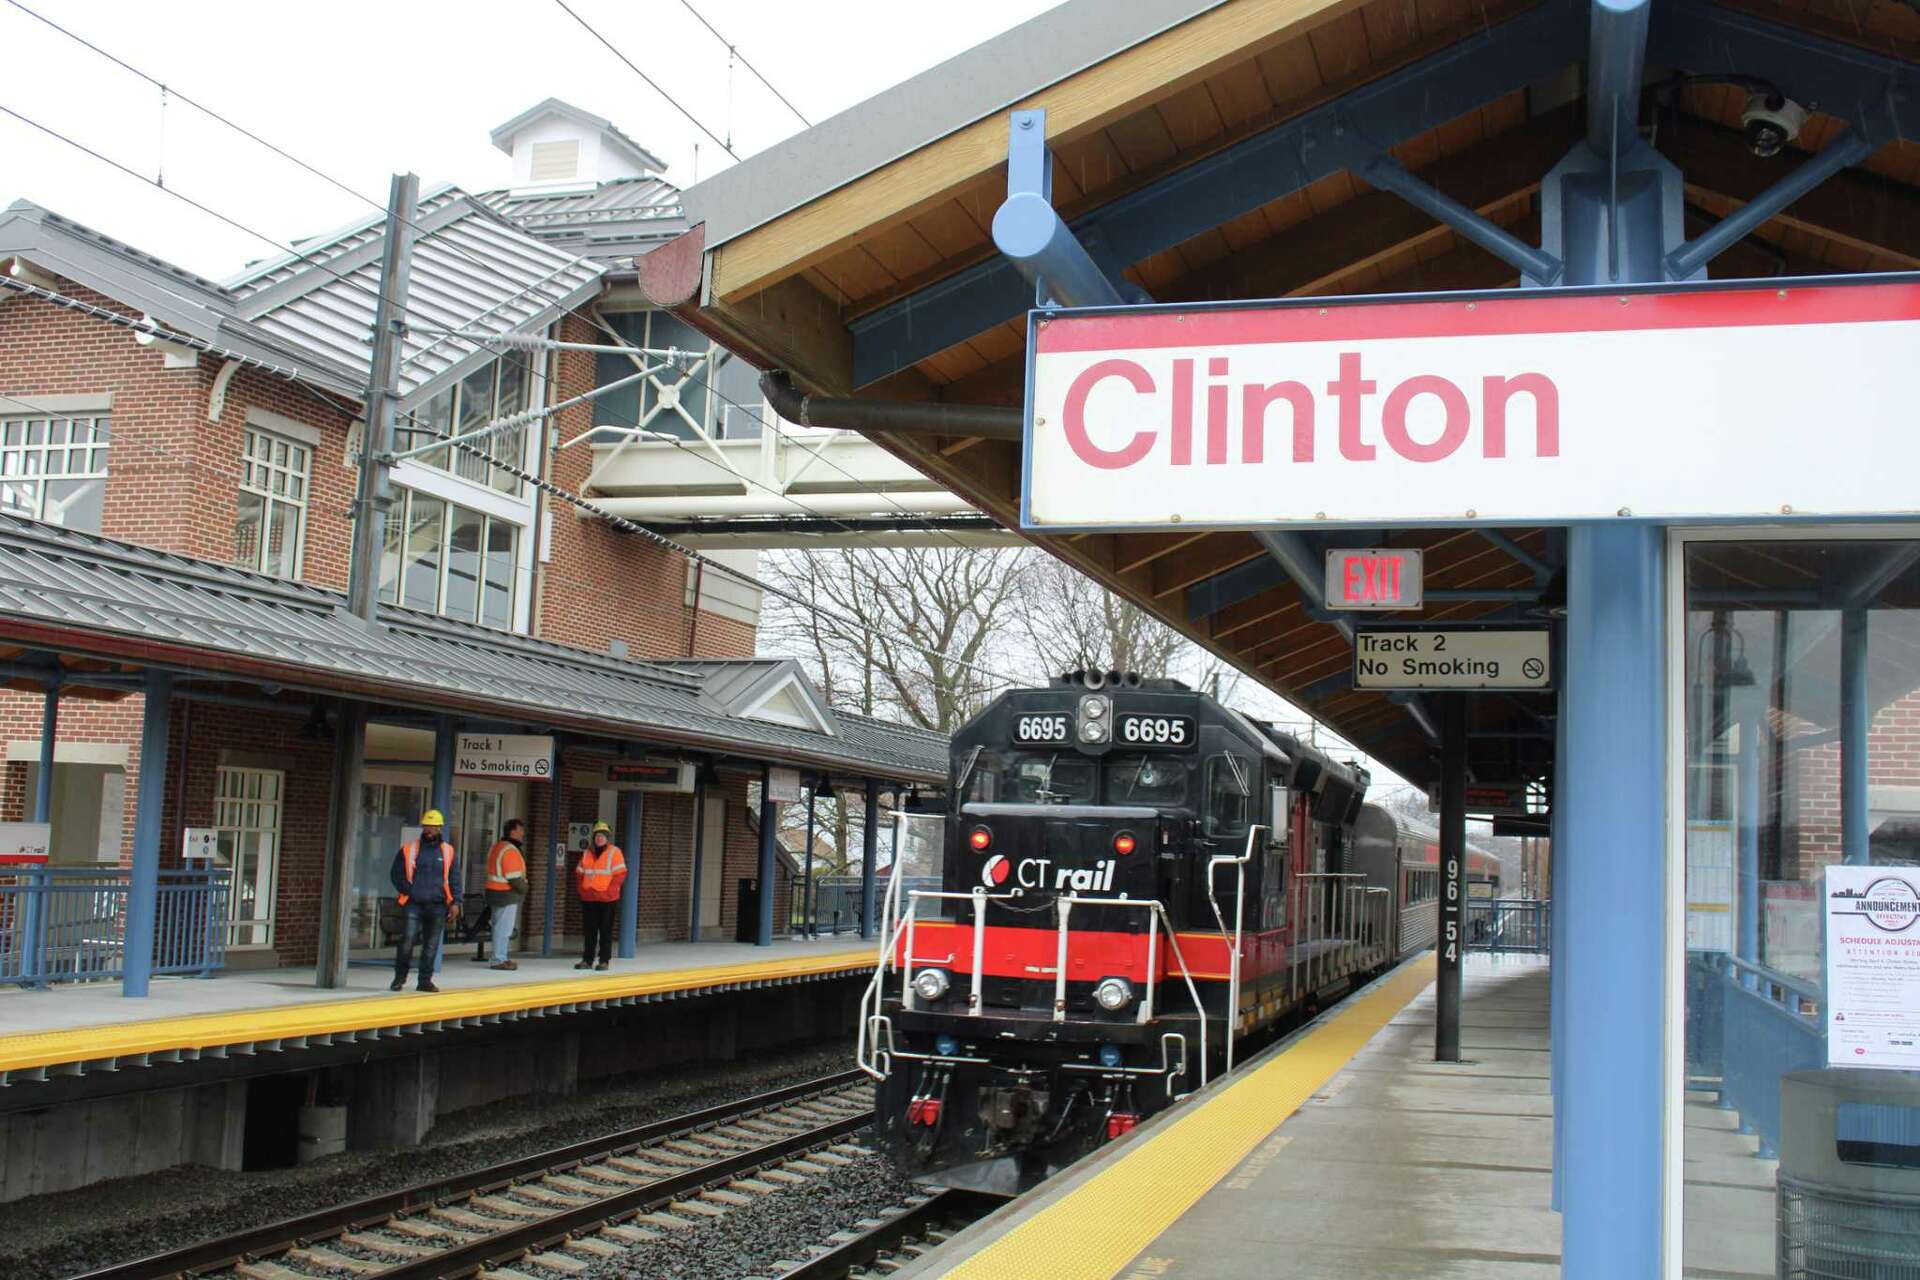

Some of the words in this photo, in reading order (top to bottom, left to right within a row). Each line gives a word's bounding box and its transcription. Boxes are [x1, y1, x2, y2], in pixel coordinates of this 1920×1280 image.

[1062, 352, 1560, 470] Clinton
[1343, 556, 1404, 601] EXIT
[1360, 635, 1418, 652] Track
[1433, 634, 1446, 652] 2
[1359, 659, 1388, 676] No
[1402, 658, 1500, 678] Smoking
[1019, 717, 1066, 740] 6695
[1124, 718, 1185, 743] 6695
[462, 738, 492, 751] Track
[497, 740, 502, 751] 1
[460, 758, 477, 771] No
[481, 760, 530, 776] Smoking
[1017, 858, 1051, 888] CT
[1055, 860, 1116, 891] rail
[1840, 937, 1881, 945] SCHEDULE
